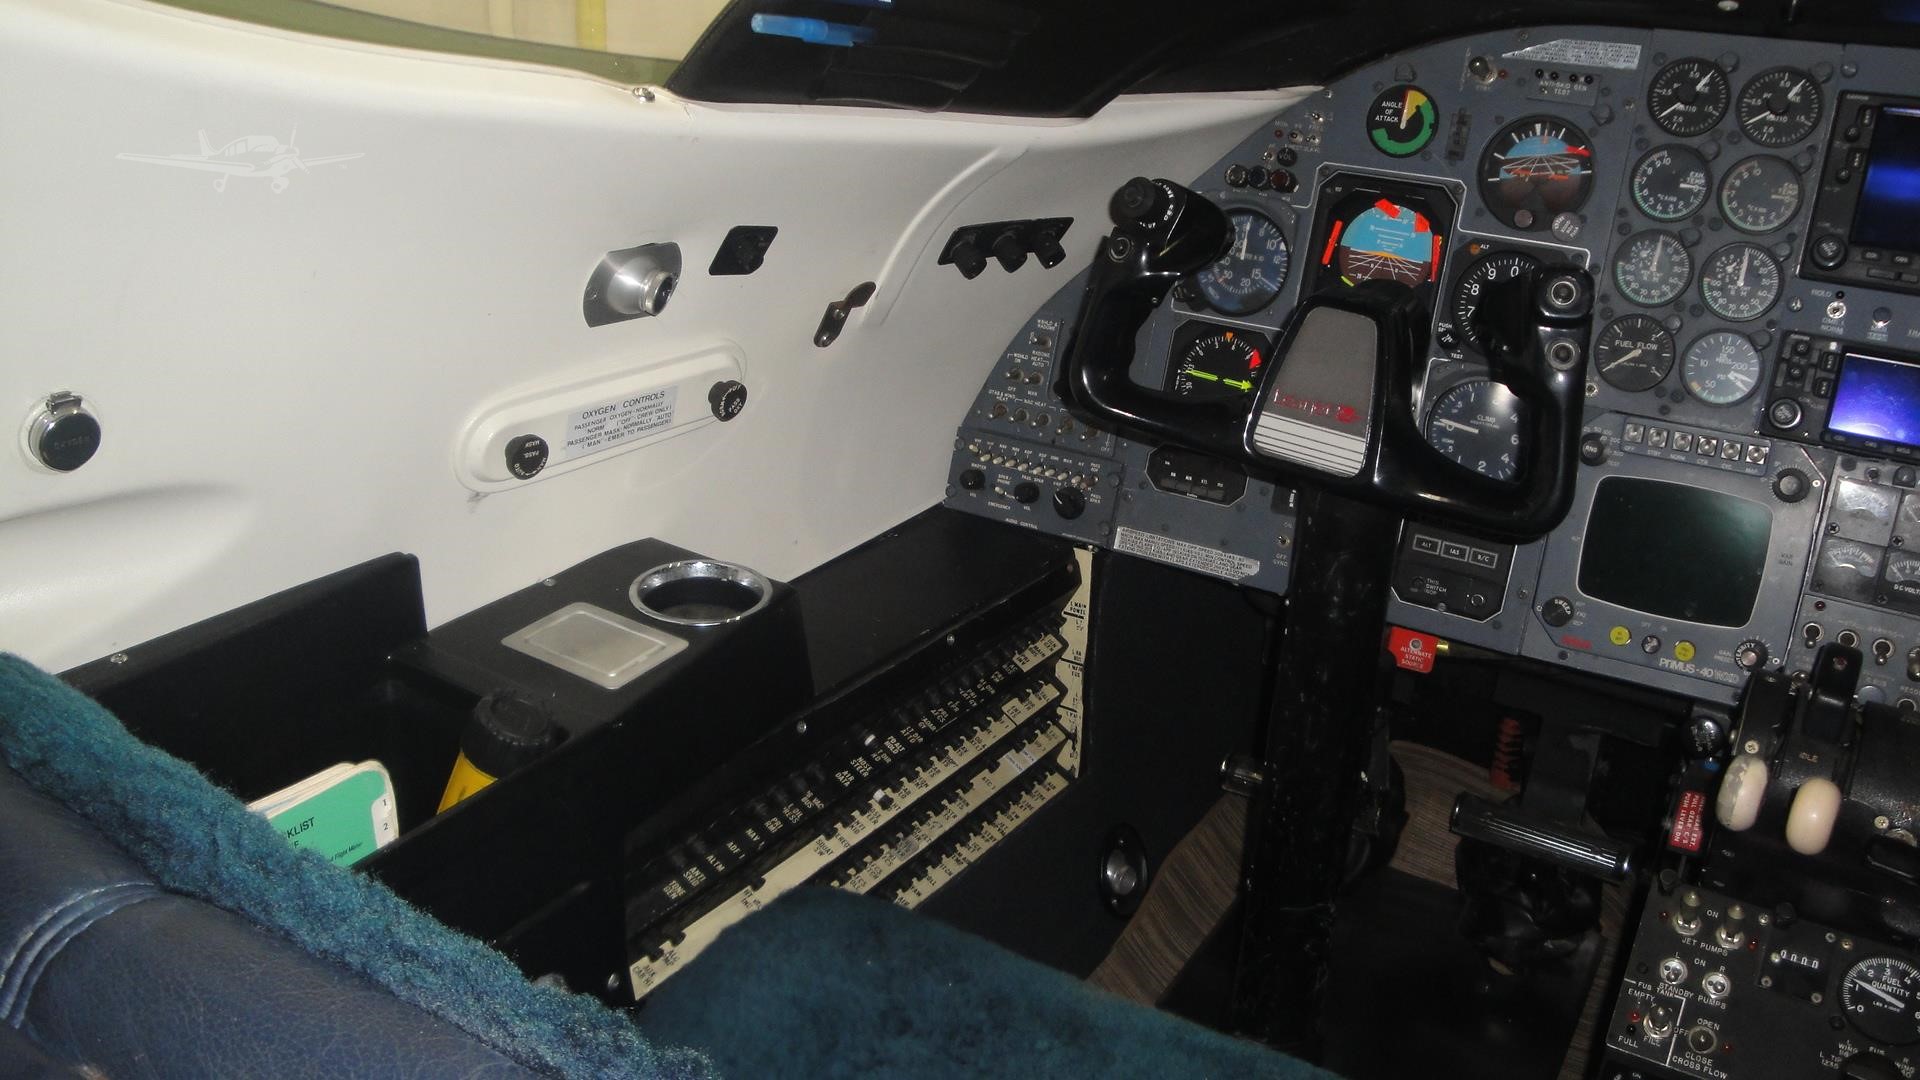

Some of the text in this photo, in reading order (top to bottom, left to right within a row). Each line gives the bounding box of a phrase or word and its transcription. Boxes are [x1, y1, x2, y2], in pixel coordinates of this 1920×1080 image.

[1381, 101, 1403, 109] ANGLE
[1375, 114, 1399, 122] ATTACK
[1662, 157, 1672, 166] 10
[1642, 176, 1647, 184] 7
[1648, 197, 1654, 205] 5
[1678, 200, 1684, 209] 2
[1668, 204, 1674, 212] 3
[1266, 241, 1276, 250] 10
[1252, 268, 1262, 280] 15
[1488, 268, 1496, 281] 9
[1510, 266, 1520, 278] 0
[1240, 278, 1250, 288] 20
[1470, 282, 1480, 296] 8
[1468, 304, 1476, 318] 7
[1614, 340, 1658, 350] FUEL FLOW
[1731, 362, 1748, 370] 200
[582, 391, 665, 420] OXYGEN CONTROLS
[574, 410, 632, 431] PASSENGER OXYGEN
[1477, 414, 1496, 424] CLIMB
[1510, 413, 1518, 423] 4
[568, 431, 602, 446] PASSENGER
[656, 412, 672, 421] AUTO
[1510, 434, 1519, 445] 6
[1500, 453, 1510, 464] 4
[1670, 454, 1686, 462] NORM
[1477, 460, 1486, 472] 2
[1449, 548, 1460, 556] IAS
[1477, 554, 1490, 562] B/C
[1426, 583, 1447, 592] SWITCH
[1070, 606, 1086, 615] POWER
[1554, 598, 1572, 615] SWEEP
[1400, 646, 1432, 658] ALTERNATE
[1402, 658, 1424, 670] SOURCE
[1404, 654, 1424, 664] STATIC
[850, 760, 869, 778] STEER
[857, 756, 872, 771] NOSE
[835, 772, 852, 787] DATA
[842, 770, 855, 782] AIR
[382, 798, 387, 806] 1
[1682, 792, 1692, 808] PUSH
[1691, 794, 1700, 808] PULL
[792, 808, 804, 820] OIL
[1678, 809, 1688, 830] LEVER
[1686, 810, 1696, 830] GEAR
[384, 822, 389, 832] 2
[746, 828, 760, 842] NAV
[726, 842, 740, 854] ADF
[816, 839, 833, 856] SQUAT
[706, 854, 725, 872] ALTM
[683, 871, 700, 887] SKID
[690, 866, 706, 882] ANTI
[670, 880, 686, 895] TONE
[1706, 908, 1720, 919] ON
[1681, 936, 1728, 957] JET PUMPS
[1694, 958, 1707, 968] ON
[1720, 965, 1726, 973] R
[1866, 970, 1874, 978] 2
[1884, 968, 1891, 976] 3
[1882, 976, 1902, 988] FUEL
[1904, 976, 1911, 984] 4
[1637, 980, 1676, 998] FUS TANK
[1872, 980, 1910, 998] QUANTITY
[1658, 982, 1726, 1010] STANDBY PUMPS
[1856, 1004, 1864, 1012] 0
[1696, 1017, 1720, 1030] OPEN
[1673, 1025, 1690, 1037] OFF
[1618, 1036, 1638, 1049] FULL
[1838, 1044, 1858, 1054] WING
[1684, 1050, 1713, 1067] CLOSE
[1672, 1054, 1728, 1080] CROSS FLOW
